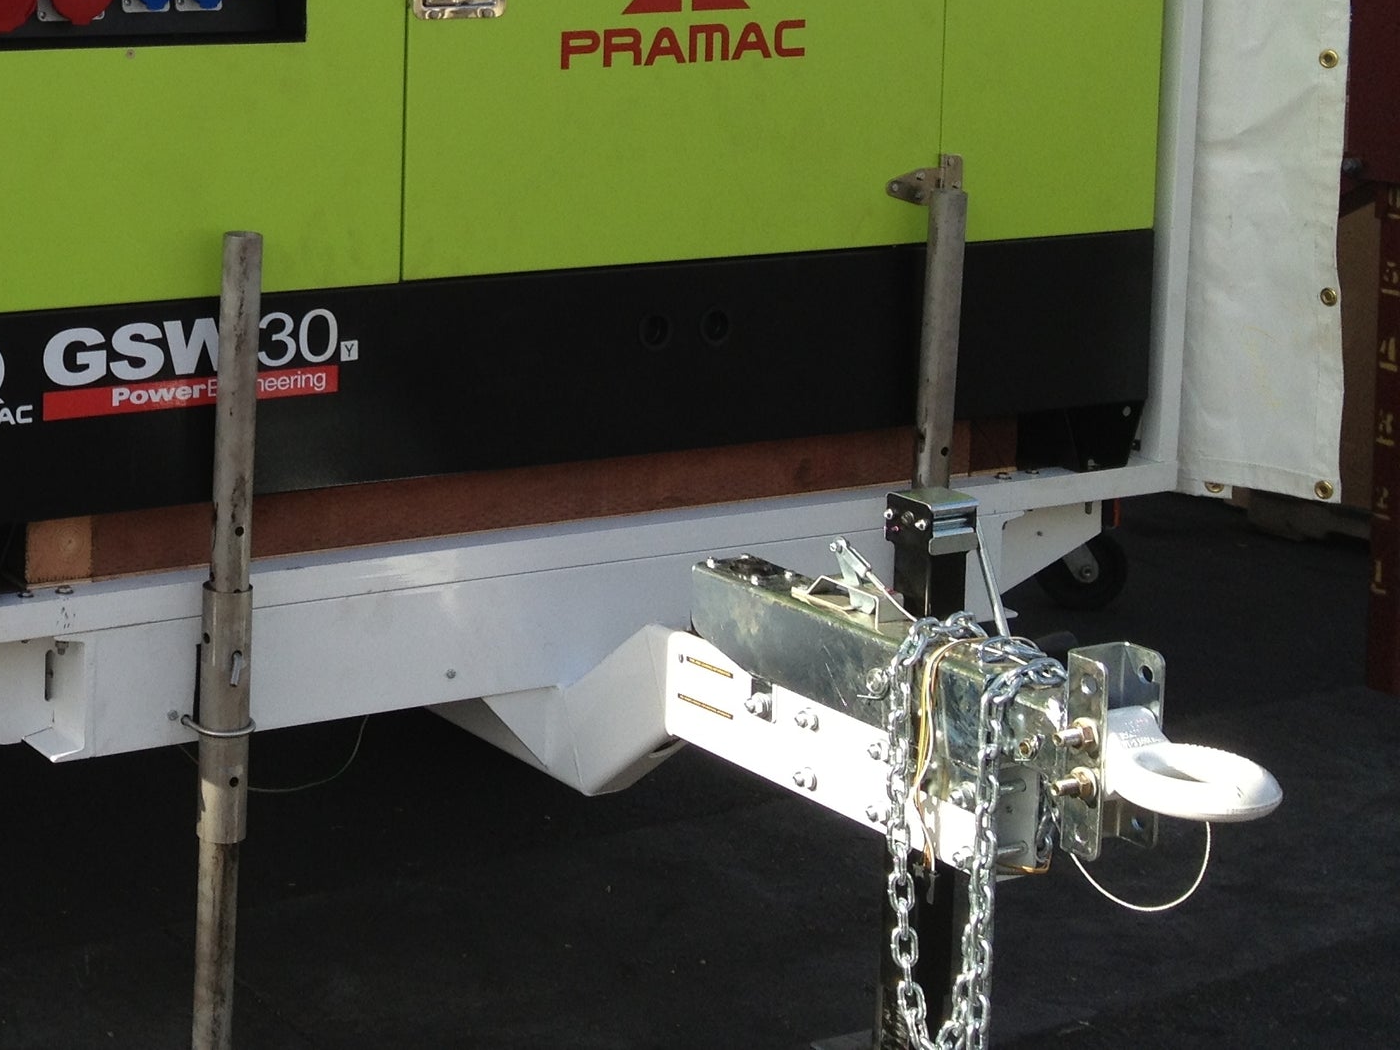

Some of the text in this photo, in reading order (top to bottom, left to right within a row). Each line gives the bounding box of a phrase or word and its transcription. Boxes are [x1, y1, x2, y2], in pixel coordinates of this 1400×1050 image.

[560, 19, 806, 70] PRAMAC
[43, 317, 218, 386] GSW
[258, 308, 338, 367] 30
[112, 370, 327, 407] PowerEneering
